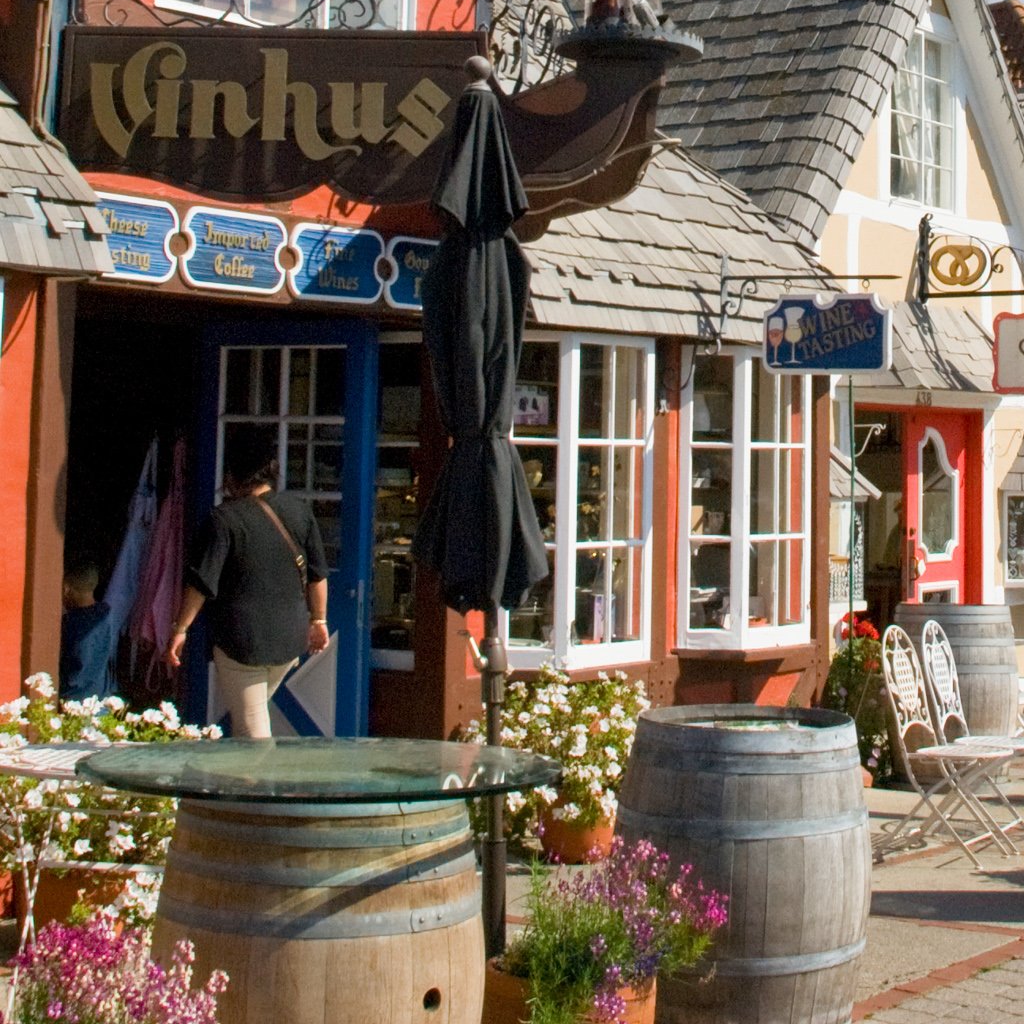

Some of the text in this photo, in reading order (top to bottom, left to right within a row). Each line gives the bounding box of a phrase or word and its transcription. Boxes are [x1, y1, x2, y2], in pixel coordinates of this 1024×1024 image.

[90, 41, 452, 161] Vinhus
[203, 222, 269, 251] Imported
[111, 243, 151, 272] sting
[213, 253, 256, 279] Coffee
[318, 266, 360, 292] Wines
[798, 303, 855, 337] WINE
[800, 320, 877, 360] TASTING
